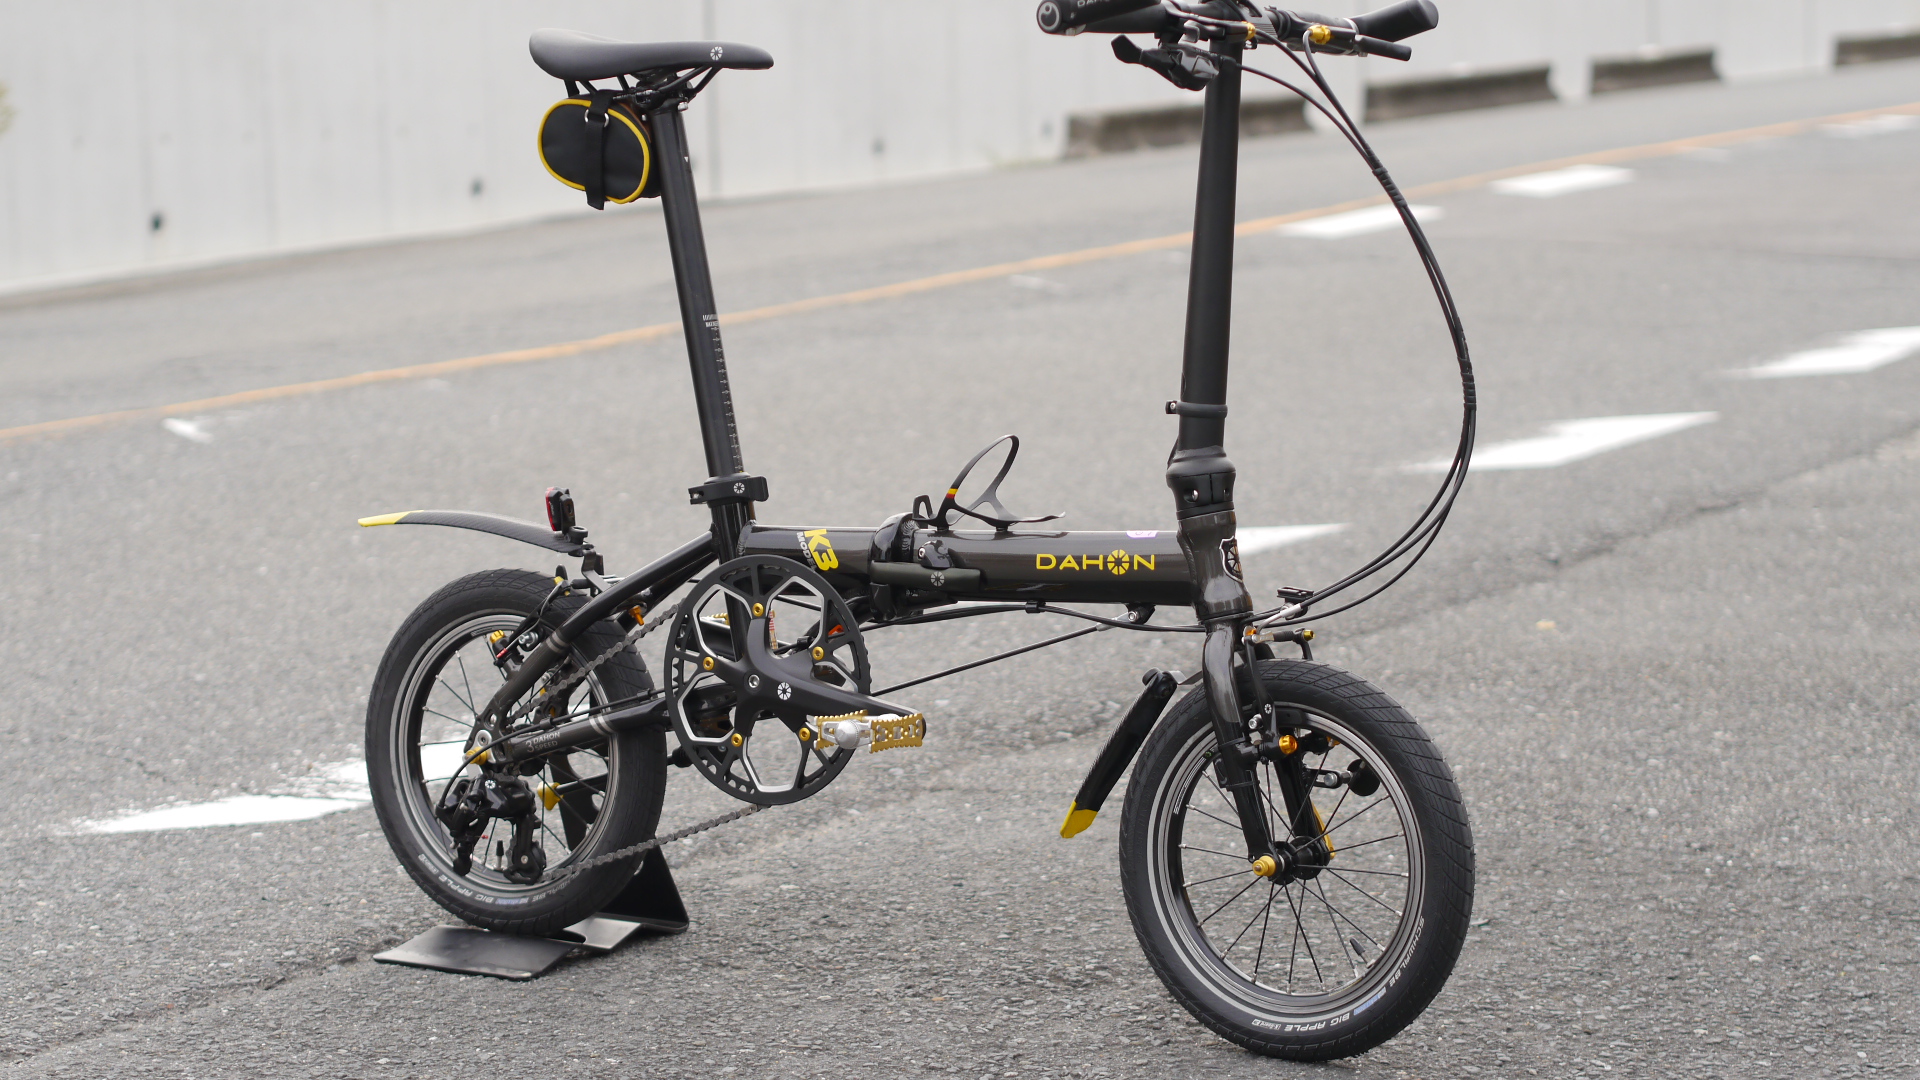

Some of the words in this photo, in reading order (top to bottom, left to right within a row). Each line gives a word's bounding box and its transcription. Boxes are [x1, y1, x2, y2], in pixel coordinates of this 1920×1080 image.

[804, 528, 839, 571] K3
[1036, 549, 1155, 575] DAHON
[533, 731, 561, 744] DAHON
[525, 740, 535, 753] 3
[534, 740, 558, 751] SPEED
[438, 874, 473, 898] APPLE
[474, 894, 494, 904] BIG
[1388, 915, 1425, 988] SCHWALBE
[1329, 1012, 1350, 1026] BIG
[1284, 1020, 1327, 1032] APPLE
